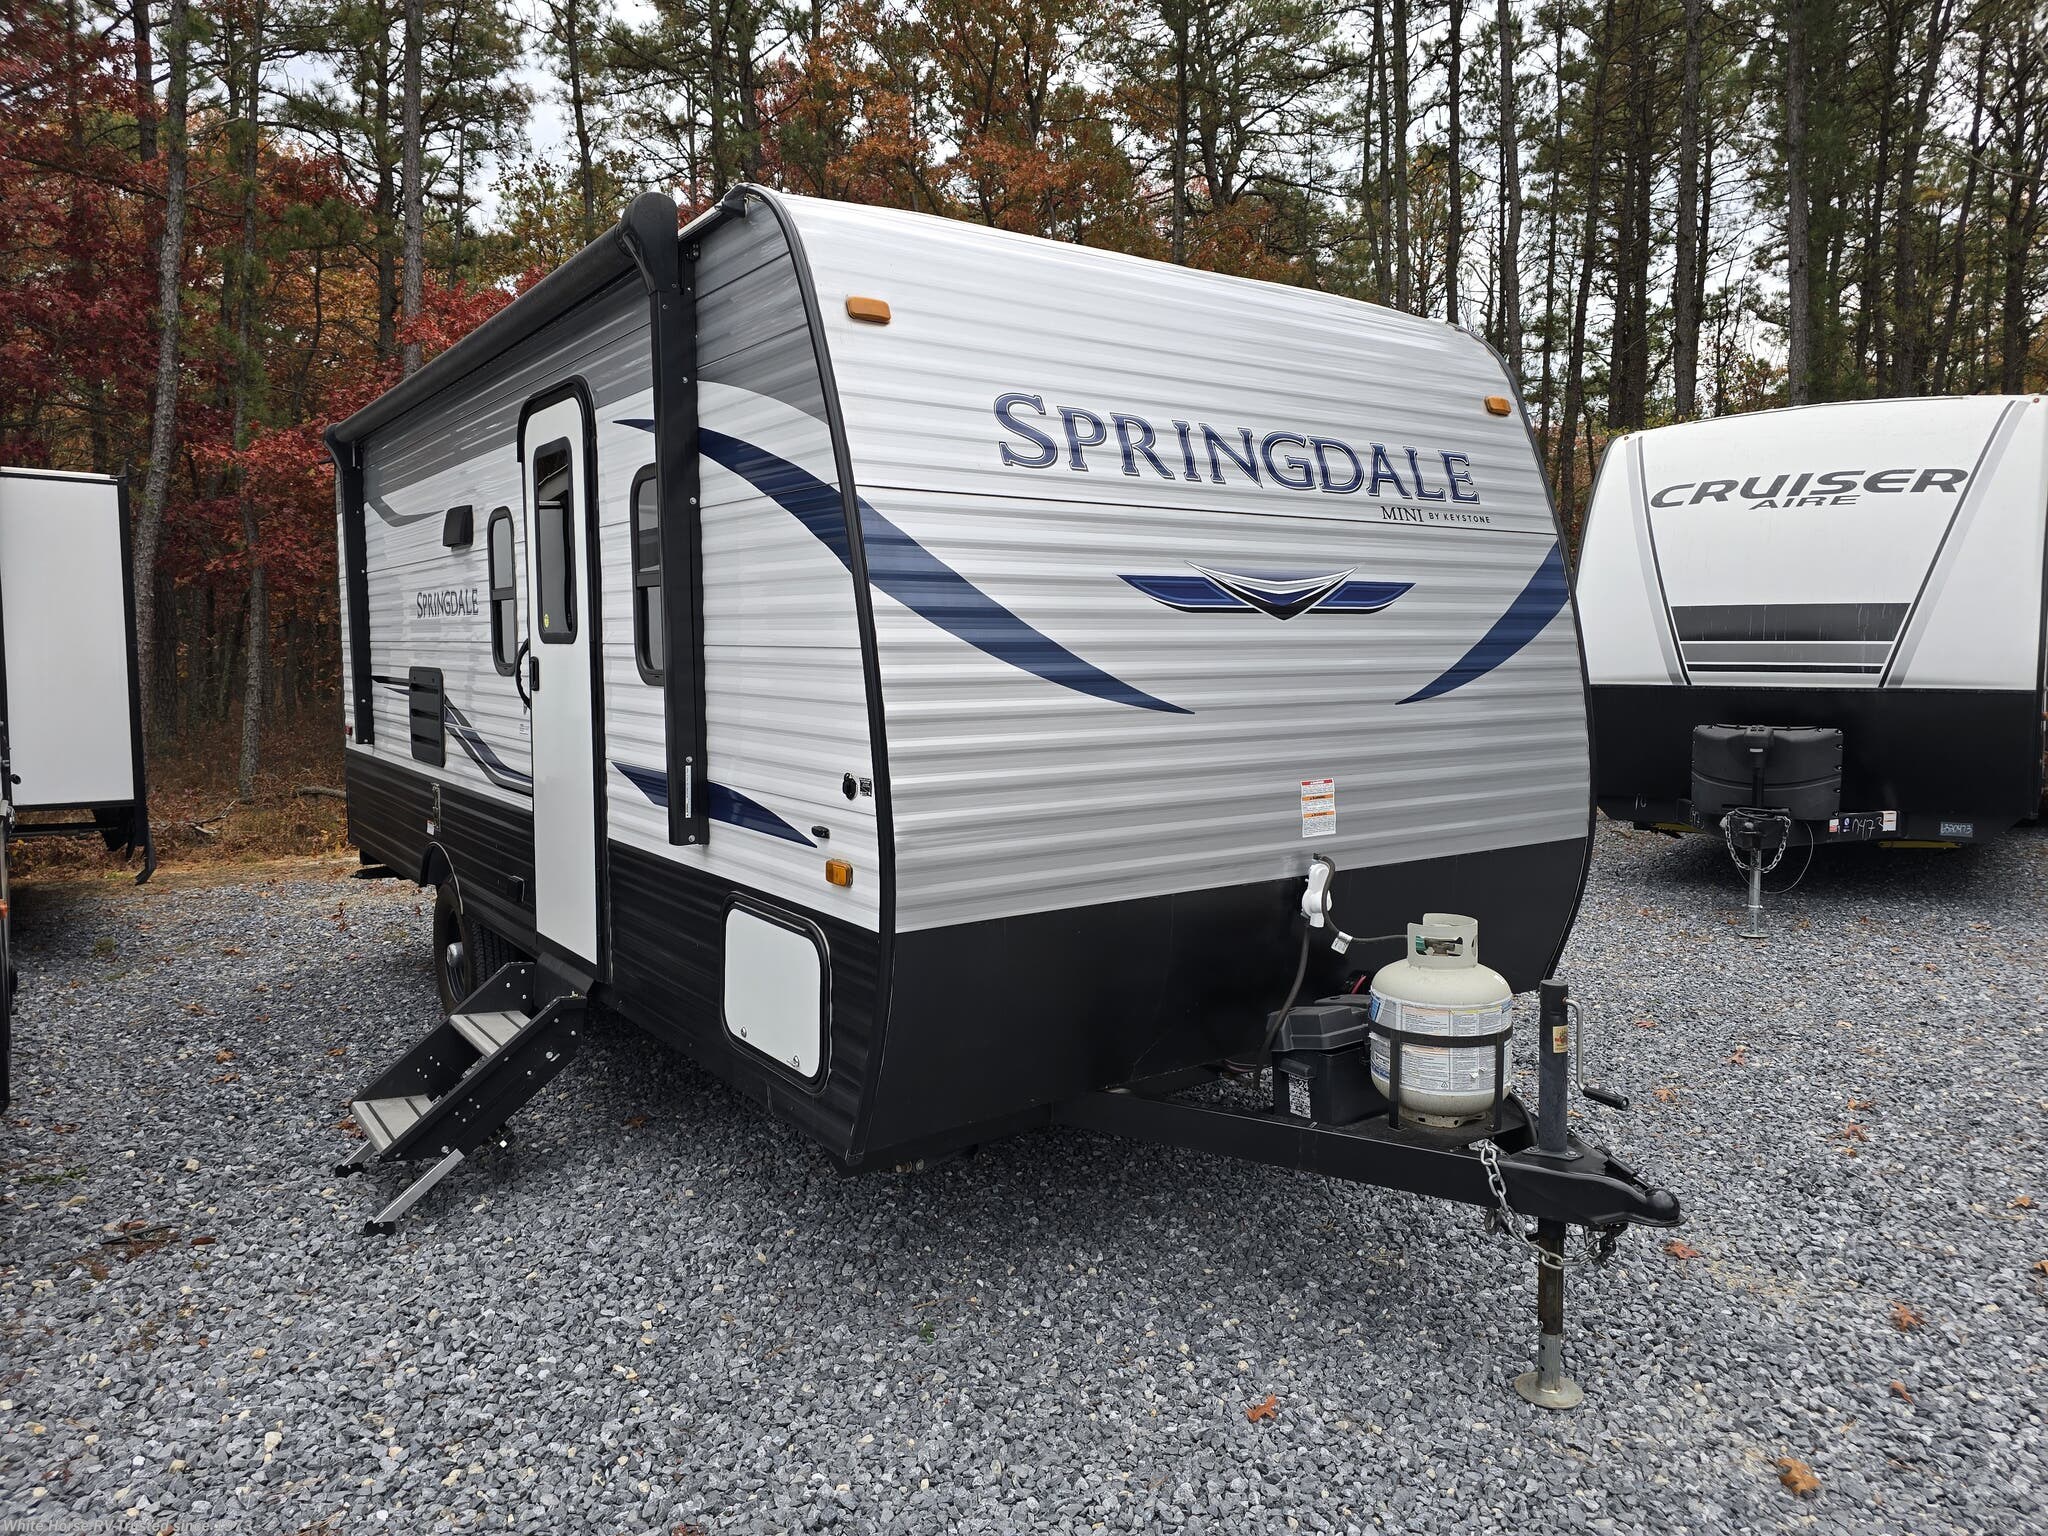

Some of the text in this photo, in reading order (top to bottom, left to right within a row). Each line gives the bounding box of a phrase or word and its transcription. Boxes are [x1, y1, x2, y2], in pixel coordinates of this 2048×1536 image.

[993, 392, 1481, 505] SPRINGDALE
[1650, 468, 1968, 508] CRUISER
[1749, 495, 1861, 510] AIRE
[1381, 506, 1491, 524] MINI BY KEYSTONE
[417, 588, 479, 618] SPRINGDALE
